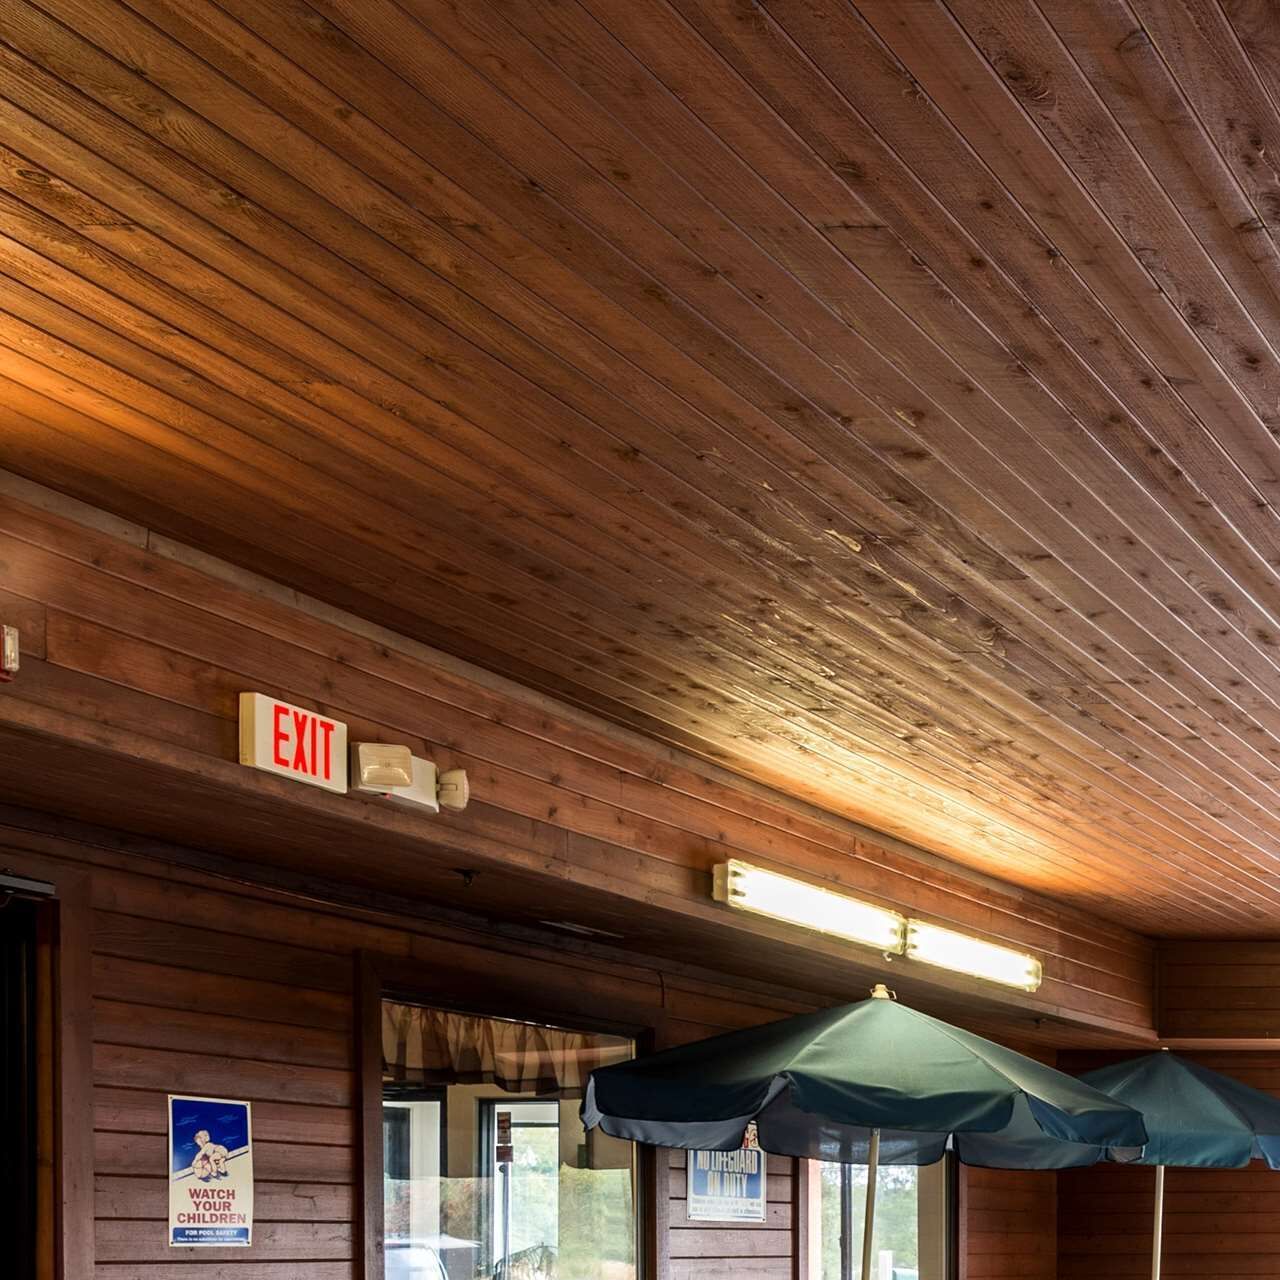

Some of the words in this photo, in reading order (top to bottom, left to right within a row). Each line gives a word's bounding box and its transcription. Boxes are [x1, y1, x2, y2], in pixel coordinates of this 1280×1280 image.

[274, 704, 335, 780] EXIT
[697, 1150, 709, 1170] NO
[711, 1149, 757, 1174] LIFEGUARD
[708, 1171, 720, 1195] ON
[724, 1173, 747, 1197] DUTY
[188, 1188, 235, 1200] WATCH
[193, 1201, 232, 1212] YOUR
[177, 1213, 246, 1224] CHILDREN
